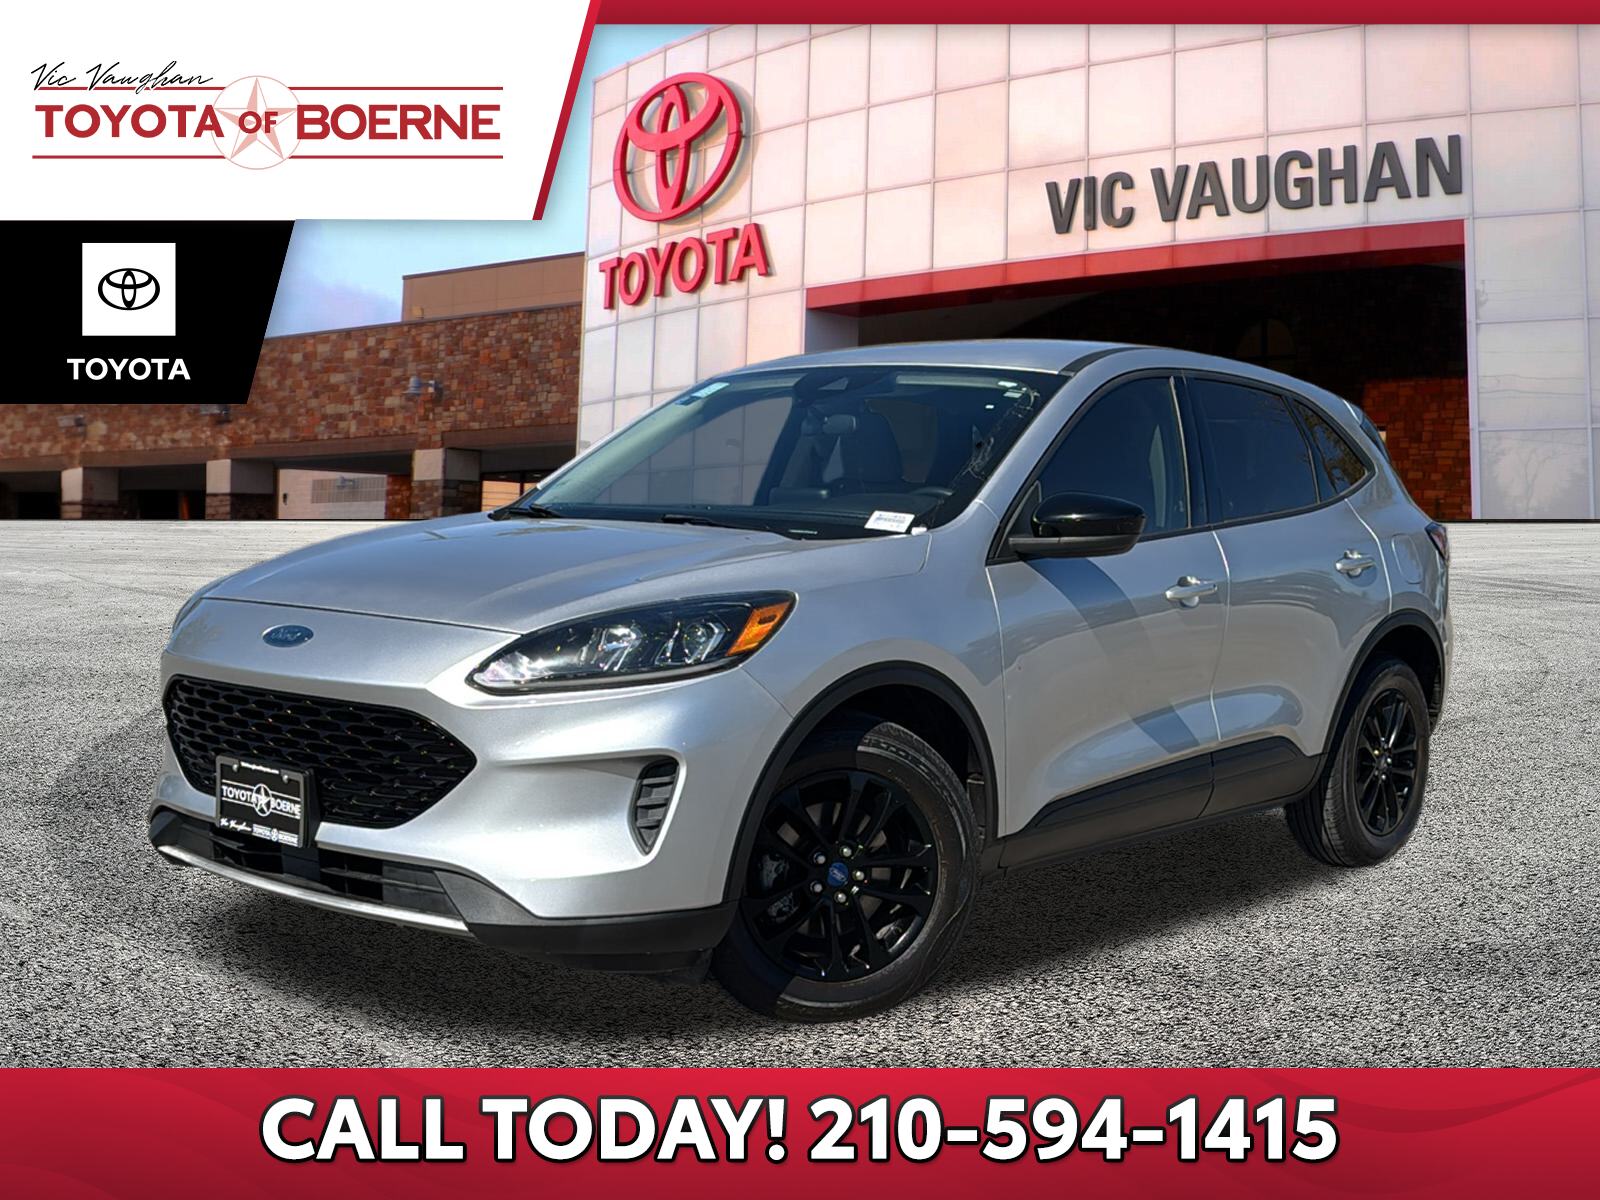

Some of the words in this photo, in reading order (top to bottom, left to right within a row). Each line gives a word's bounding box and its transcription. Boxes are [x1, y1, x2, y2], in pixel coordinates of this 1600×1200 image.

[1046, 171, 1136, 235] VIC
[1150, 134, 1464, 223] VAUGHAN
[599, 222, 770, 310] TOYOTA
[222, 785, 258, 803] TOYOTA
